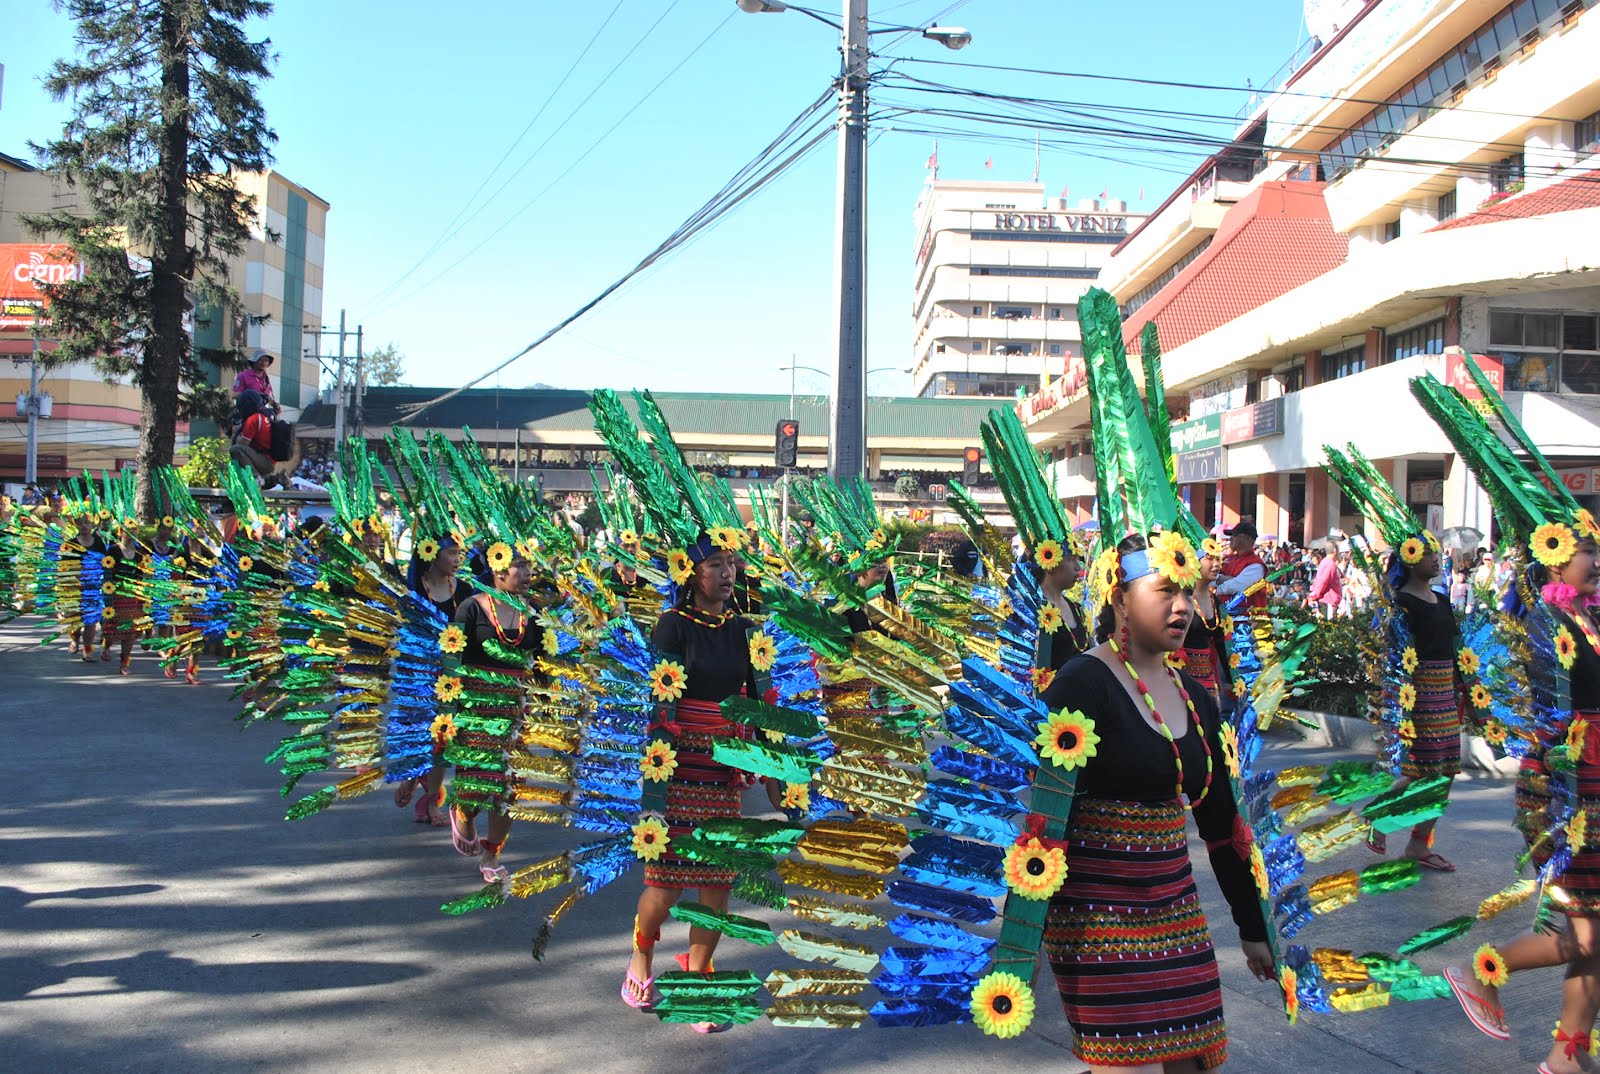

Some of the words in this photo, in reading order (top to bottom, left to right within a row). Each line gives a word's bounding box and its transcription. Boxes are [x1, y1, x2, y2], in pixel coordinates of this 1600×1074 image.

[995, 213, 1060, 230] HOTEL
[1065, 215, 1125, 232] VENIZ
[14, 258, 85, 285] cignal
[1179, 457, 1221, 480] AVON
